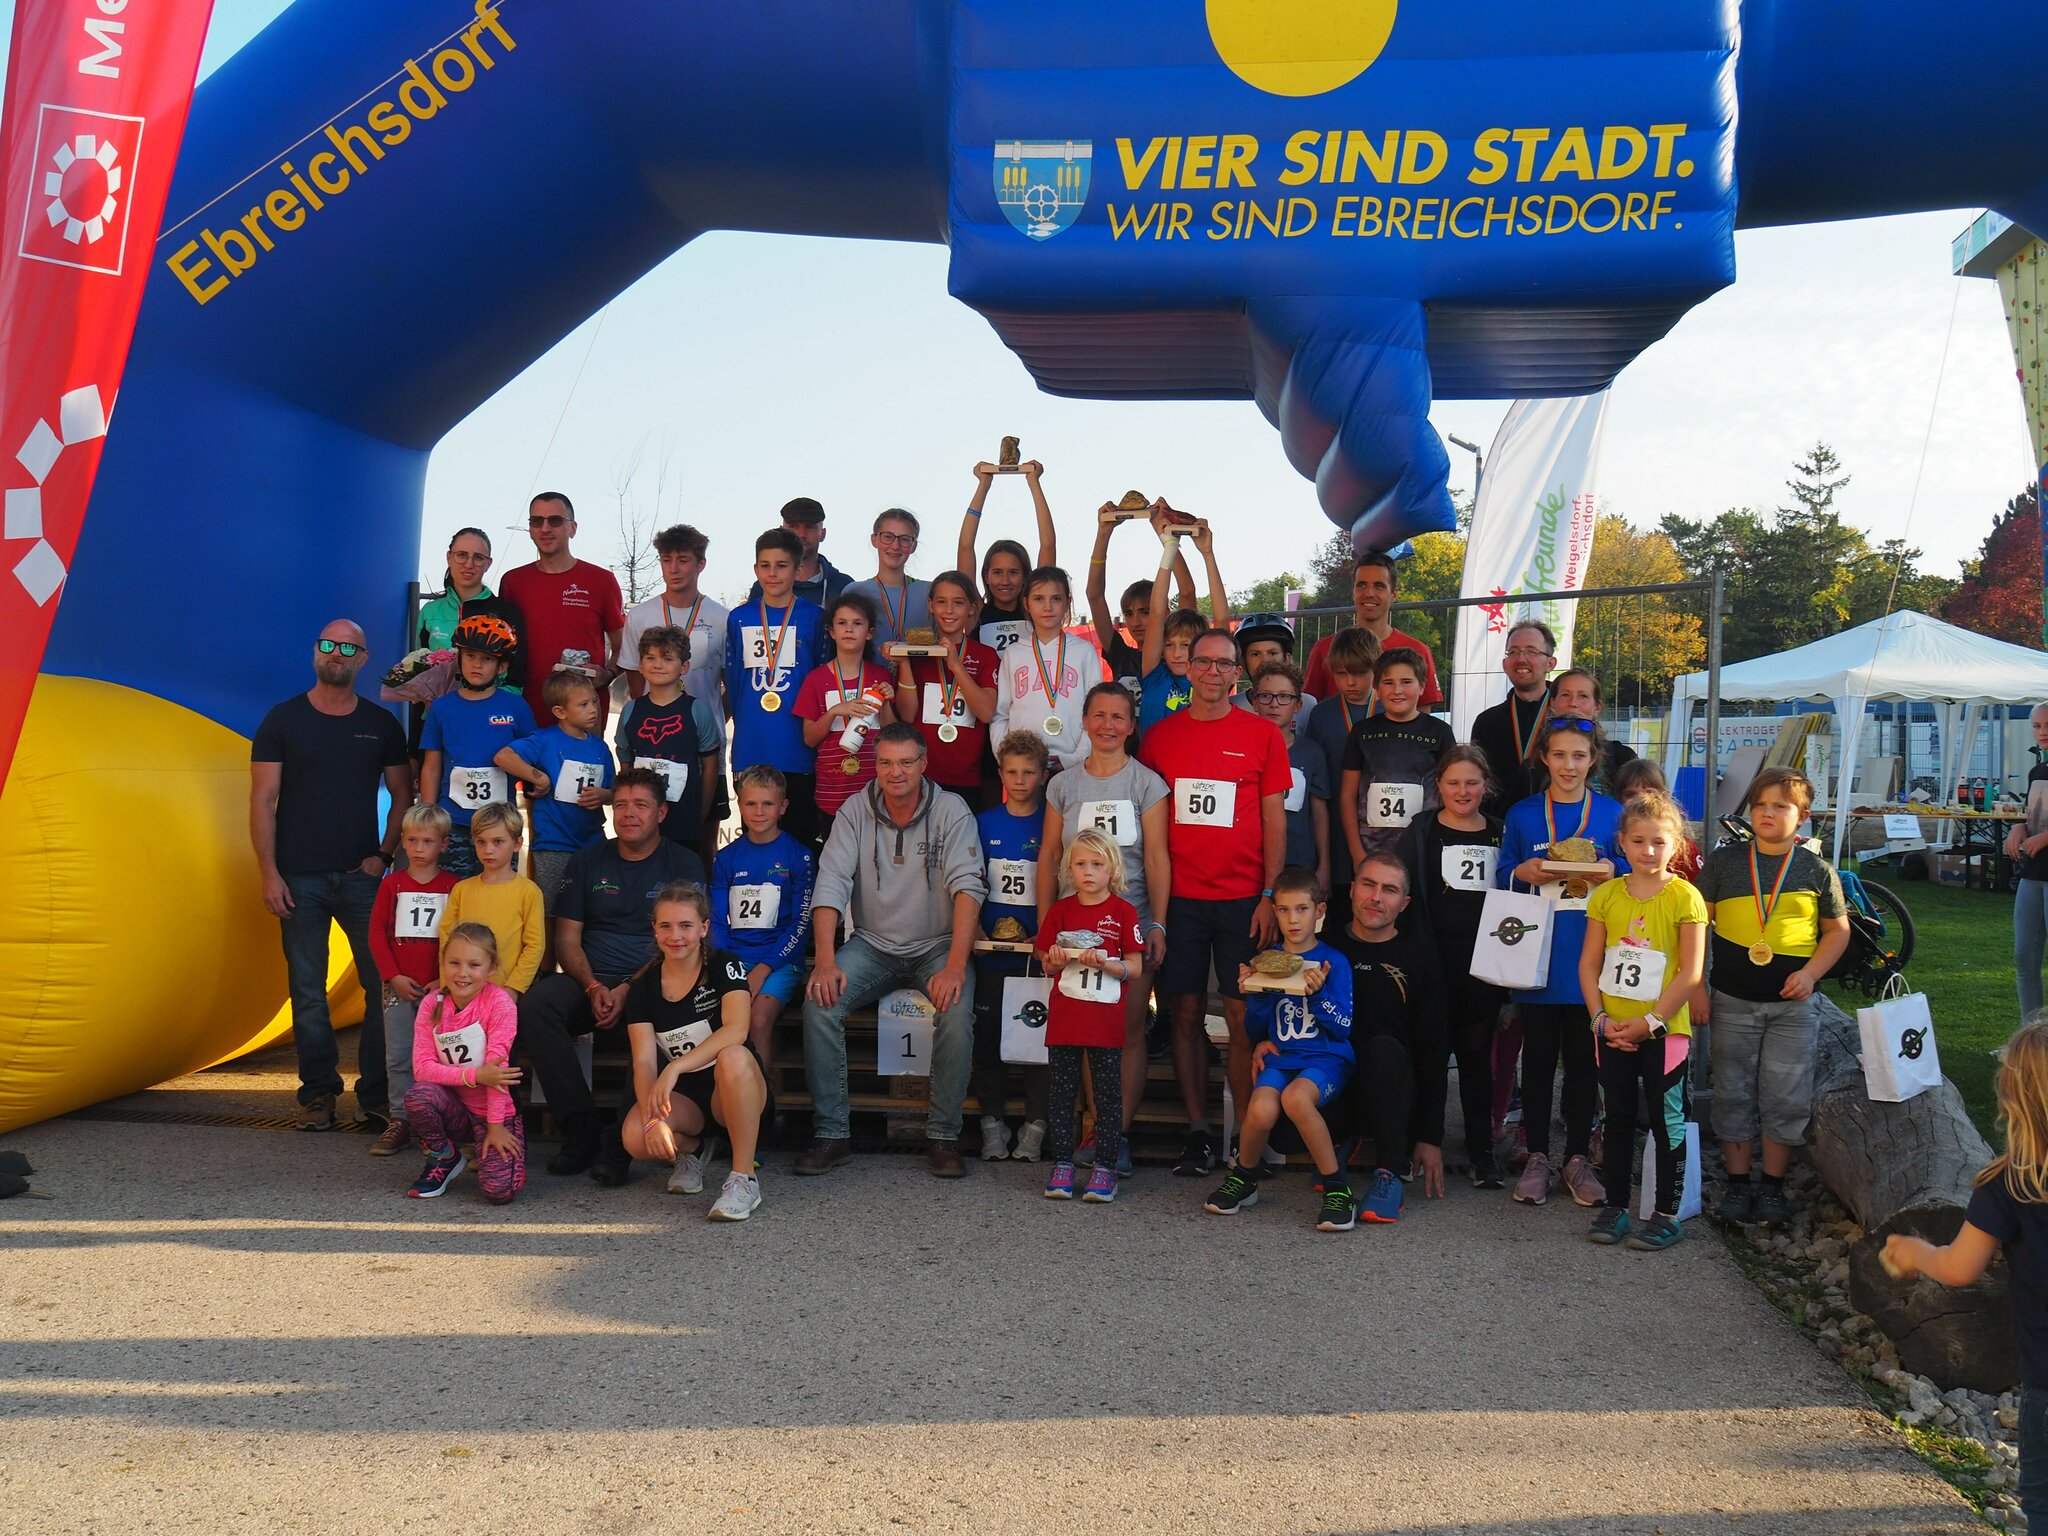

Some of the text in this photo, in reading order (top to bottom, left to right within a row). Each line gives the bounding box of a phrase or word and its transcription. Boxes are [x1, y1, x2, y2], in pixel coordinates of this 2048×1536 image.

[166, 0, 517, 305] Ebreichsdorf
[1115, 123, 1694, 190] VIER SIND STADT.
[1107, 190, 1685, 240] WIR SIND EBREICHSDORF.
[1564, 495, 1582, 589] Weigelsdorf-
[1013, 660, 1079, 699] GAP
[488, 714, 514, 725] GAP
[1397, 732, 1437, 744] BEYOND
[466, 781, 492, 801] 33
[575, 776, 596, 795] 15
[1188, 793, 1217, 816] 50
[1379, 797, 1406, 818] 34
[1094, 815, 1118, 836] 51
[1460, 860, 1485, 881] 21
[1001, 874, 1026, 896] 25
[409, 906, 437, 928] 17
[739, 899, 762, 919] 24
[1078, 967, 1103, 991] 11
[1614, 962, 1642, 988] 13
[441, 1044, 473, 1065] 12
[901, 1032, 916, 1058] 1
